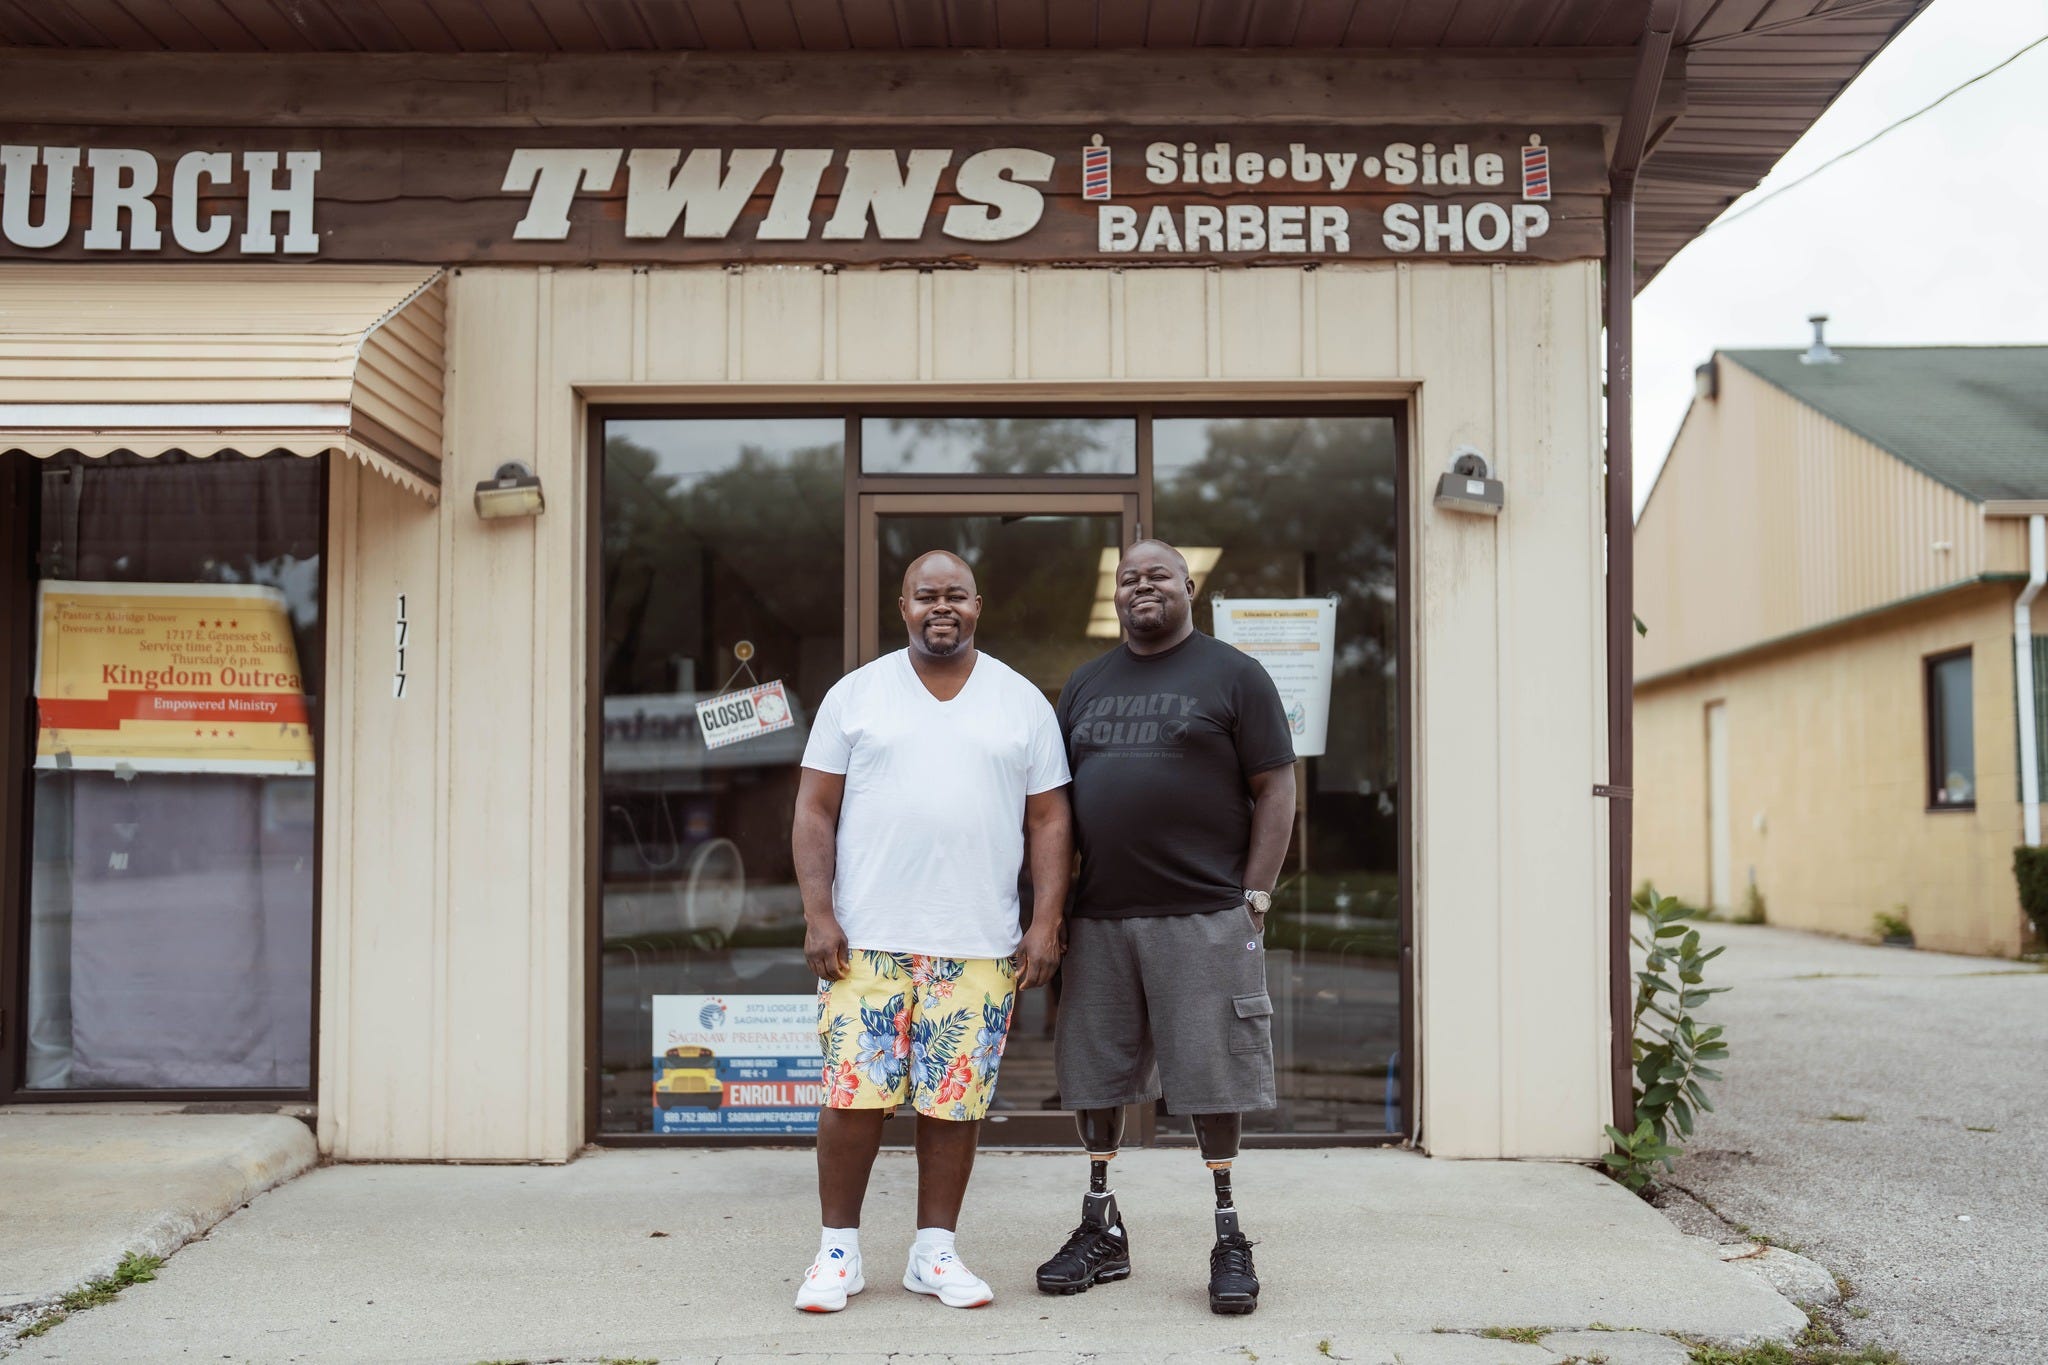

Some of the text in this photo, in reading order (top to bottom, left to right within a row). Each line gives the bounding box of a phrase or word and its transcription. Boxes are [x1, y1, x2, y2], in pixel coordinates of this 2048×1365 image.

[0, 145, 321, 253] URCH
[501, 147, 1056, 241] TWINS
[1098, 202, 1550, 253] BARBER SHOP
[139, 640, 182, 651] Service
[186, 641, 212, 652] time
[215, 641, 222, 652] 2
[166, 630, 192, 640] 1717
[208, 631, 258, 641] Genessee
[260, 631, 272, 641] St
[172, 653, 226, 666] Thursday
[229, 655, 236, 665] 6
[102, 664, 300, 690] Kingdom Outrea
[154, 697, 278, 713] Empowered Ministry
[702, 699, 754, 731] CLOSED
[1075, 720, 1160, 744] SOLID
[730, 1085, 791, 1105] ENROLL
